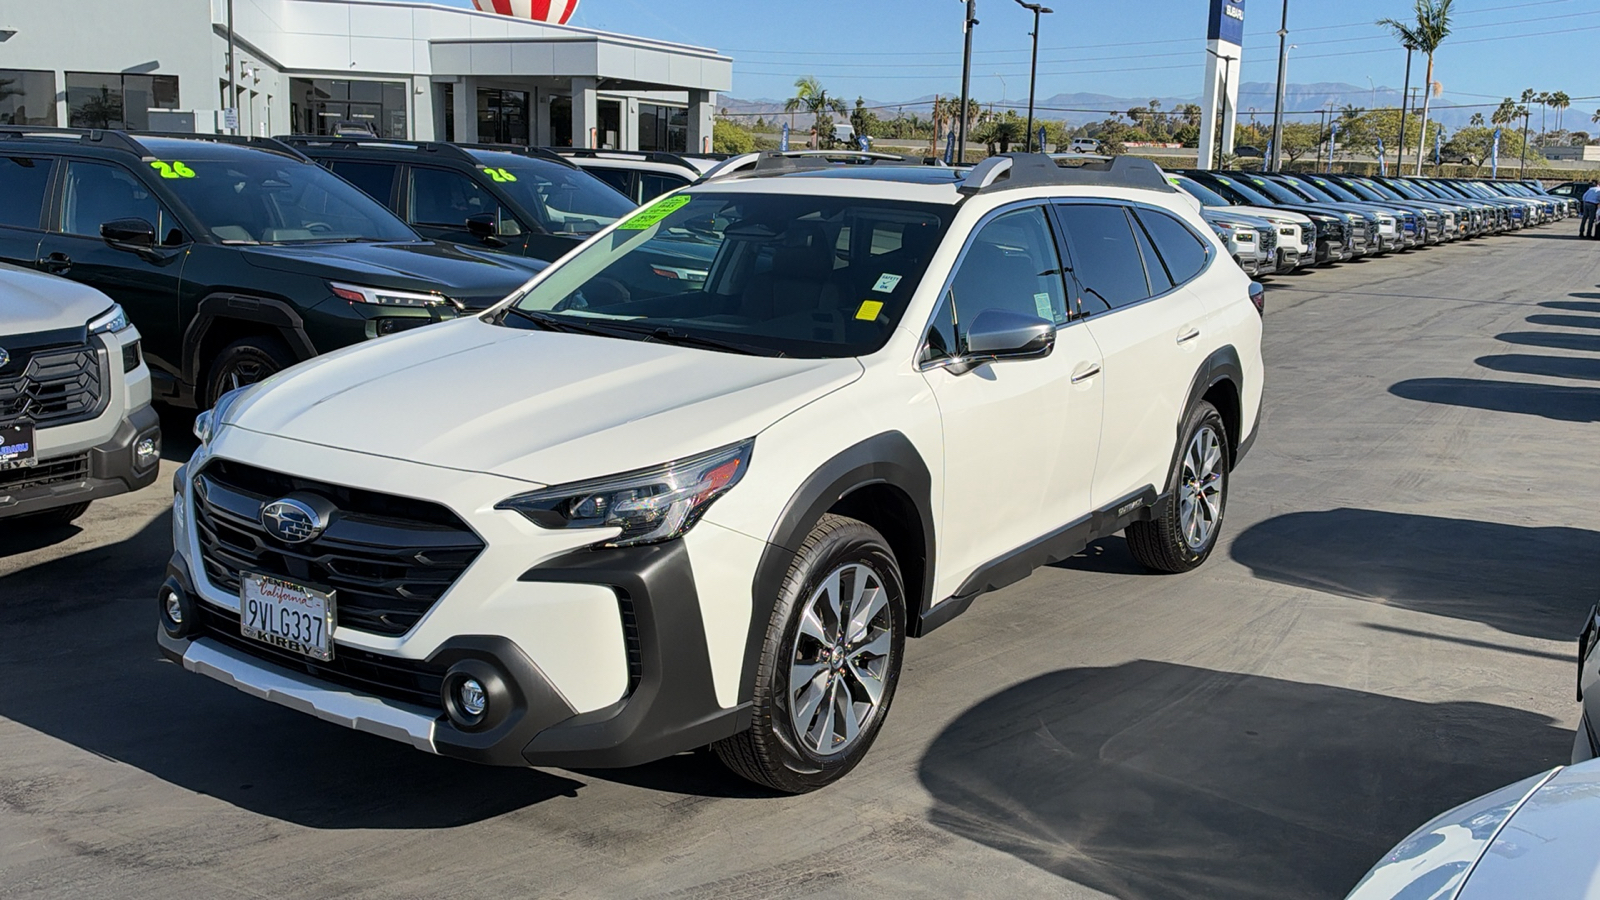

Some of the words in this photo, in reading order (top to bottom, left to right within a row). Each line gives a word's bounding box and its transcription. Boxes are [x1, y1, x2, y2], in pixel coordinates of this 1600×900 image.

[1226, 4, 1244, 21] SUBARU
[150, 161, 196, 178] 26
[484, 168, 517, 182] 26
[260, 581, 313, 608] California
[263, 576, 306, 595] VENTURA
[248, 599, 322, 647] 9VLG337
[257, 631, 312, 654] KIRBY
